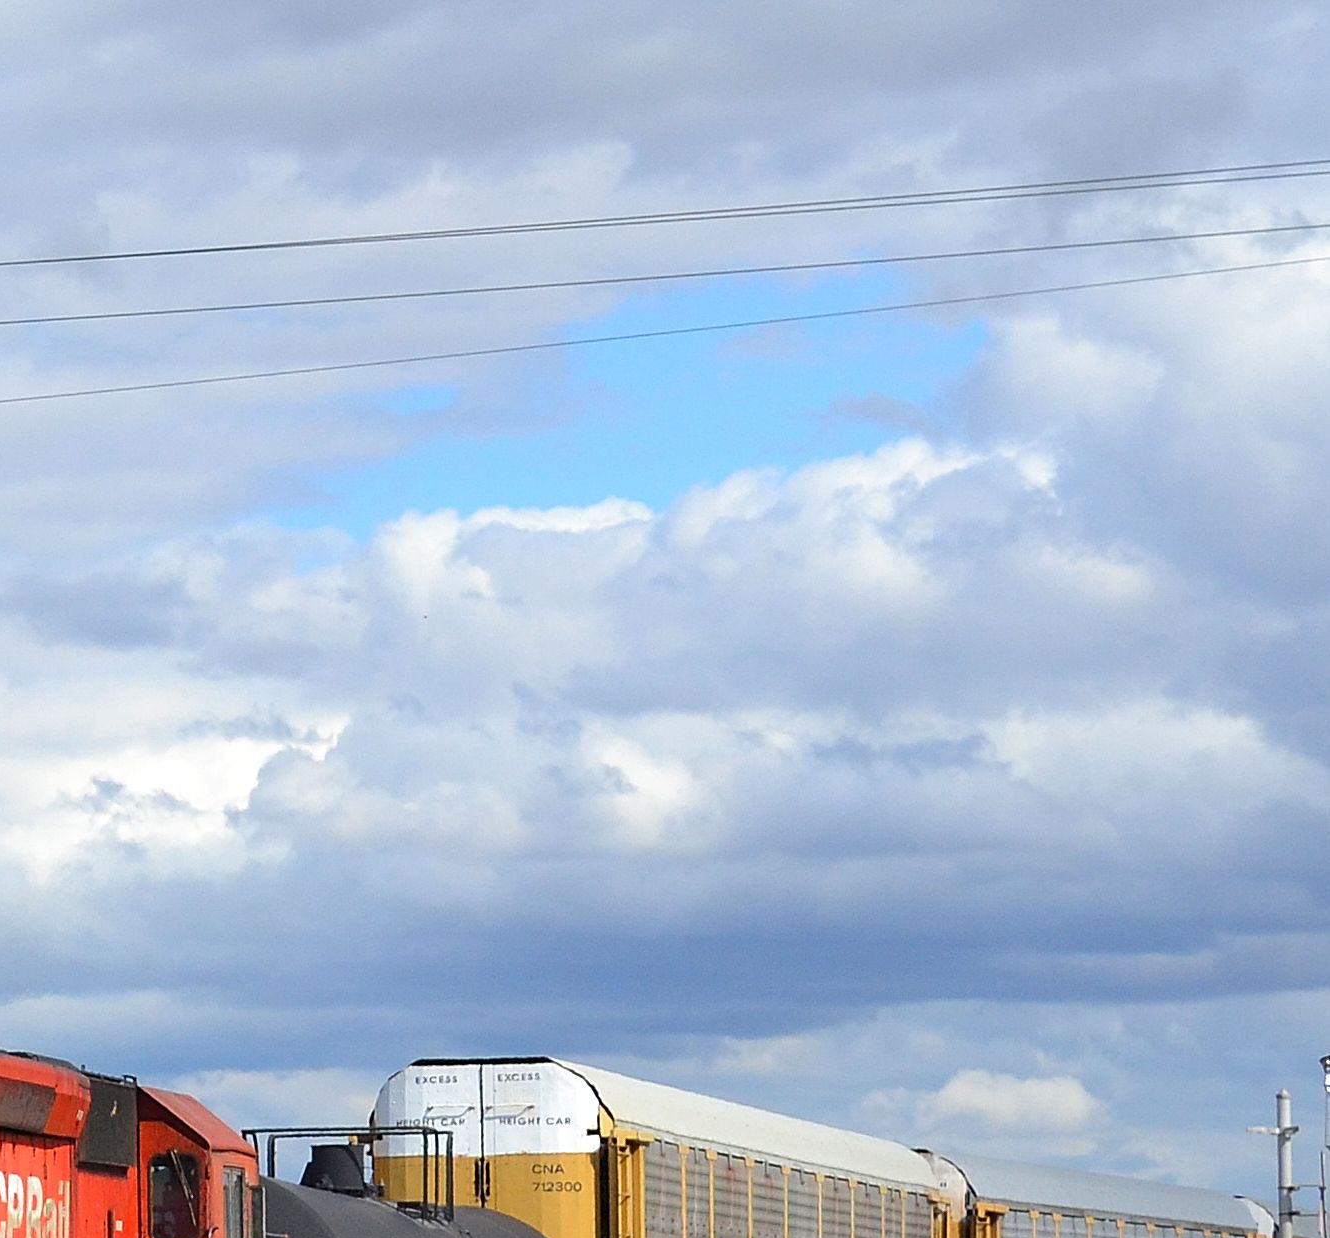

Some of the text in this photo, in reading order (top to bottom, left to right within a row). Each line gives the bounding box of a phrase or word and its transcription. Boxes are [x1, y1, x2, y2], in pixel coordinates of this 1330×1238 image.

[415, 1076, 458, 1084] EXCESS
[497, 1072, 541, 1082] EXCESS
[546, 1117, 571, 1125] CAR
[532, 1164, 565, 1174] CNA
[533, 1182, 582, 1192] 712300
